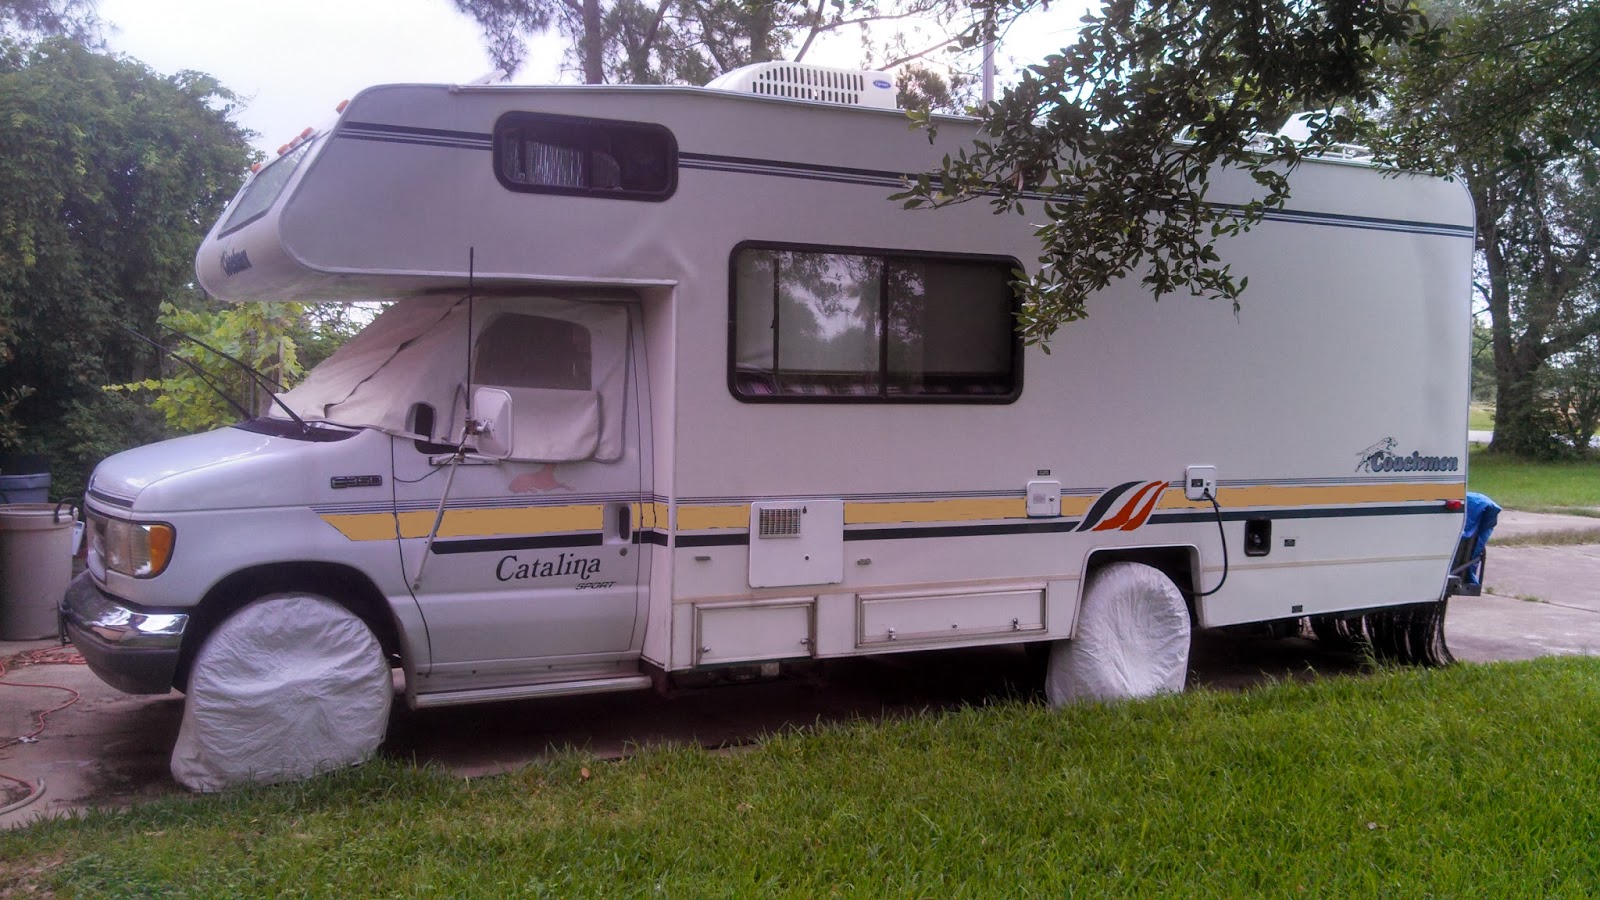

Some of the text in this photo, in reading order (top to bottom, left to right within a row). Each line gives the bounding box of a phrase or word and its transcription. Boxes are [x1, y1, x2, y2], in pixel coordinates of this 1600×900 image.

[1371, 451, 1458, 472] Coachmen
[496, 553, 600, 581] Catalina
[575, 581, 616, 590] SPORT
